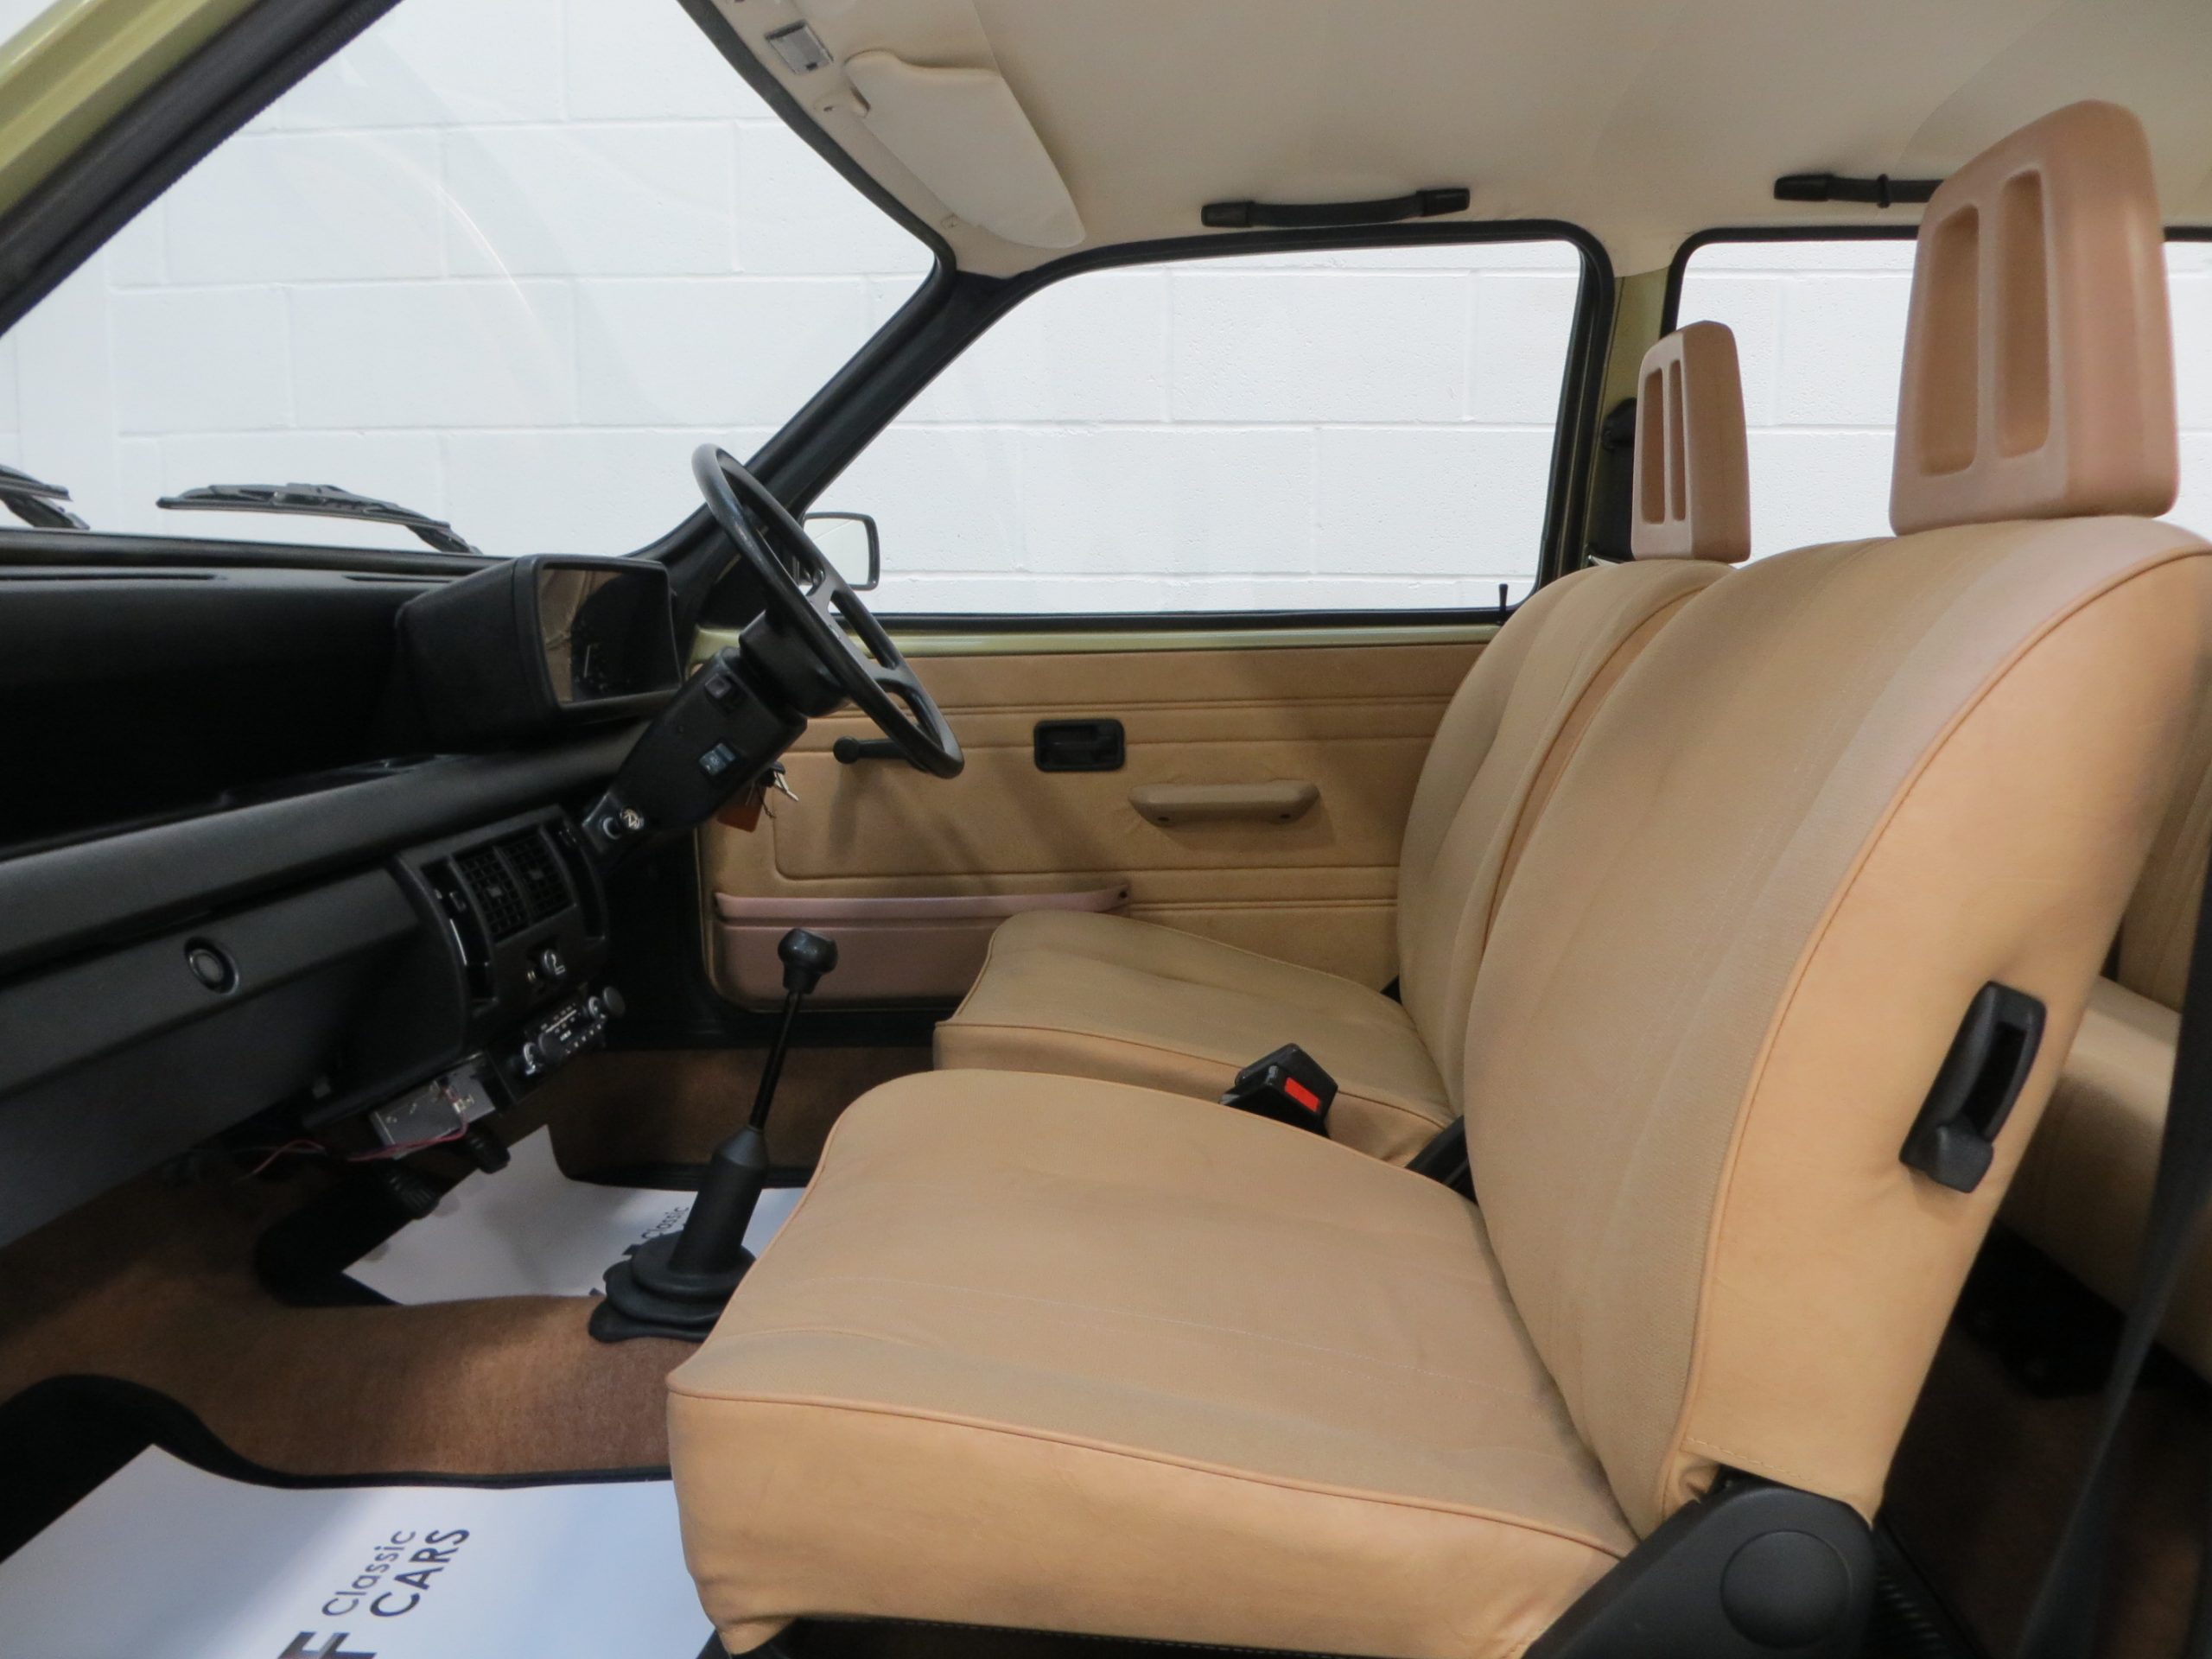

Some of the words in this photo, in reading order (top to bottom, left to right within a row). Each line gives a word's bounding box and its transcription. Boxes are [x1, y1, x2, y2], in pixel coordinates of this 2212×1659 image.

[641, 1207, 690, 1239] Classic
[321, 1530, 416, 1617] Classic
[369, 1529, 470, 1618] CARS
